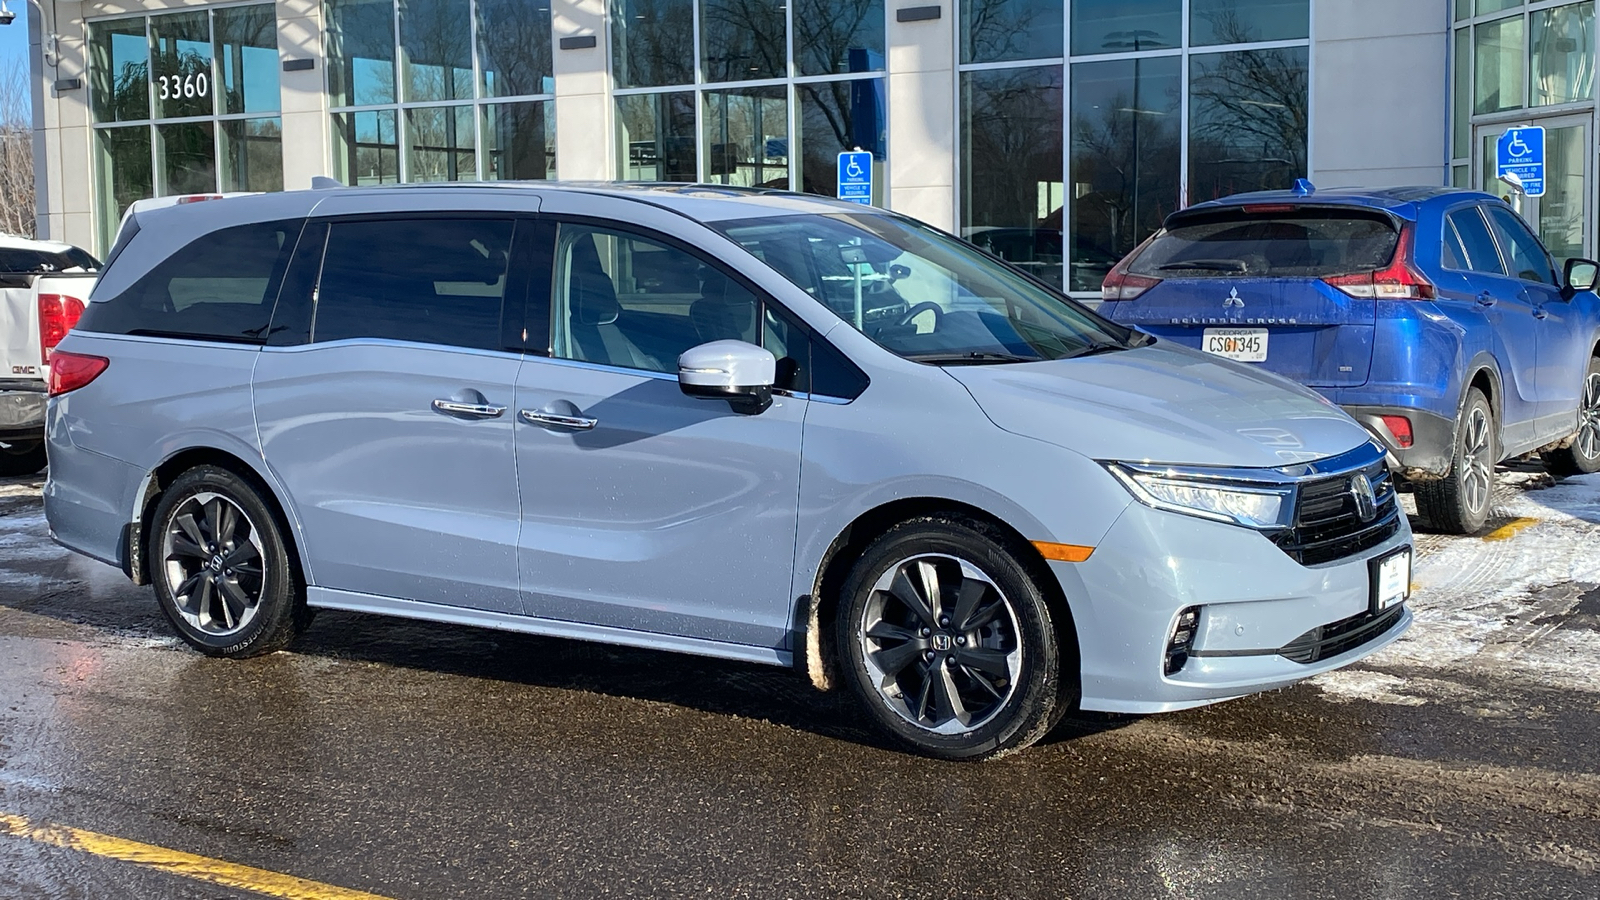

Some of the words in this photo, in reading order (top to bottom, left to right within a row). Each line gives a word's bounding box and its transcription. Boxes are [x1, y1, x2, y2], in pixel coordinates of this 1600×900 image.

[159, 72, 208, 100] 3360
[1209, 336, 1260, 353] CSG1345
[12, 365, 35, 374] GMC
